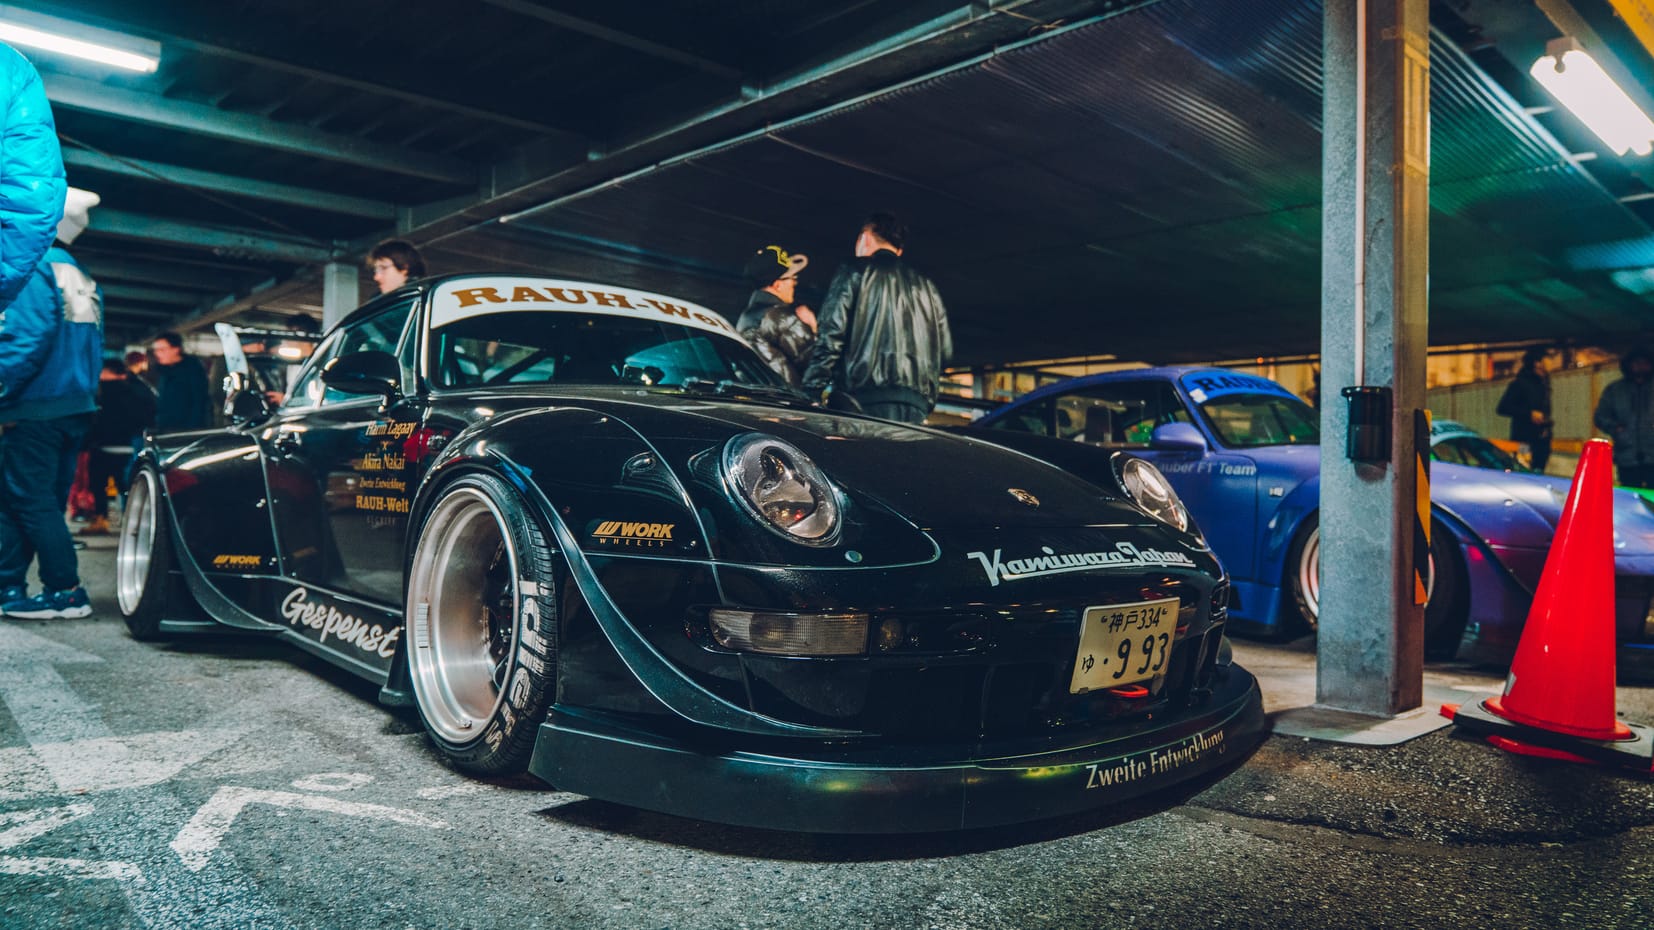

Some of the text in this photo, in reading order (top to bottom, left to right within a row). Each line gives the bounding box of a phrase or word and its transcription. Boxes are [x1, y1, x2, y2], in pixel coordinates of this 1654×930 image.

[451, 286, 733, 332] RAUH-Wel
[362, 452, 405, 470] Akira Nakai
[1219, 463, 1257, 476] Team
[356, 495, 409, 513] RAUH-Welt
[620, 521, 675, 539] WORK
[599, 537, 665, 547] WHEELS
[229, 555, 261, 565] WORK
[967, 542, 1196, 587] Kamiwaza Japan
[281, 587, 401, 658] Gespenst
[1085, 757, 1147, 790] Zweite
